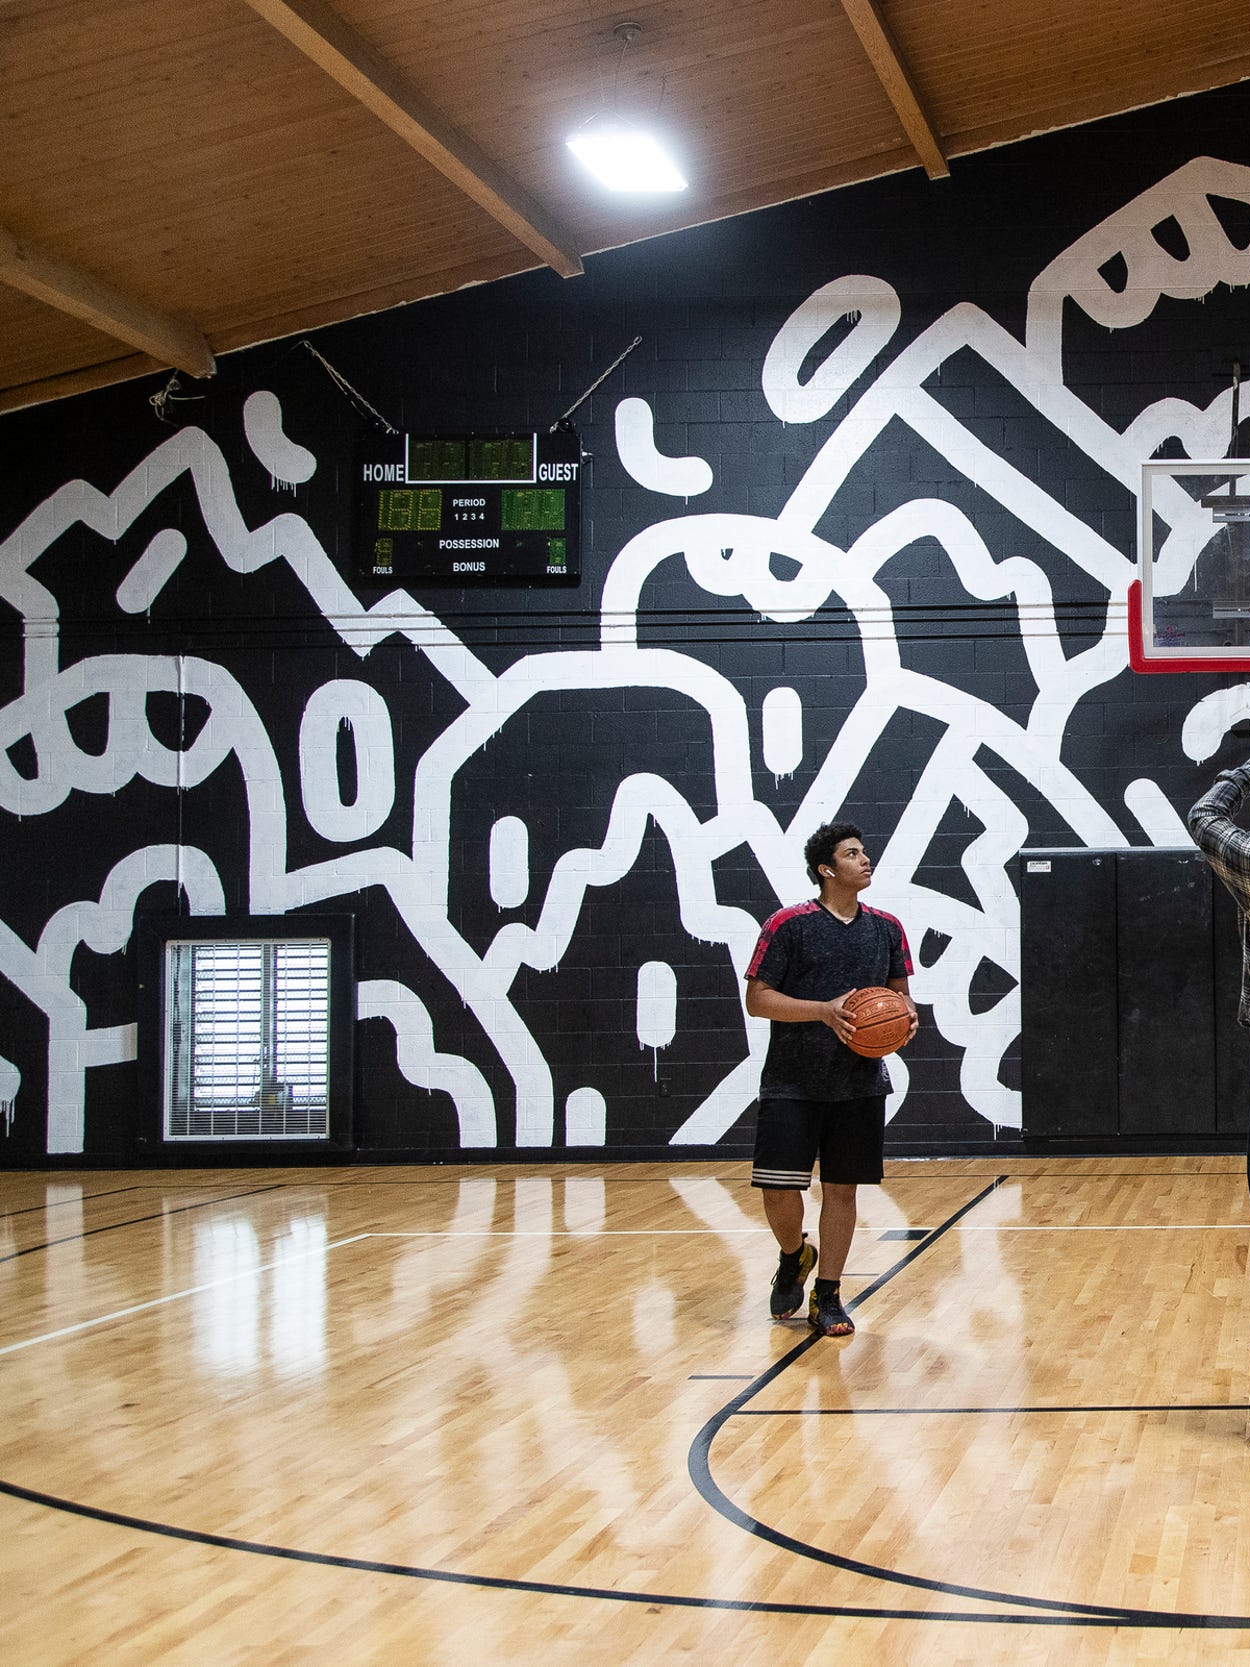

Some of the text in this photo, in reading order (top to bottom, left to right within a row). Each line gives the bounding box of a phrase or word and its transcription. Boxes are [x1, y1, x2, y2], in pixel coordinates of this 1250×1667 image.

[364, 464, 404, 481] HOME
[539, 463, 578, 481] GUEST
[440, 539, 499, 549] POSSESSION
[453, 562, 485, 571] BONUS
